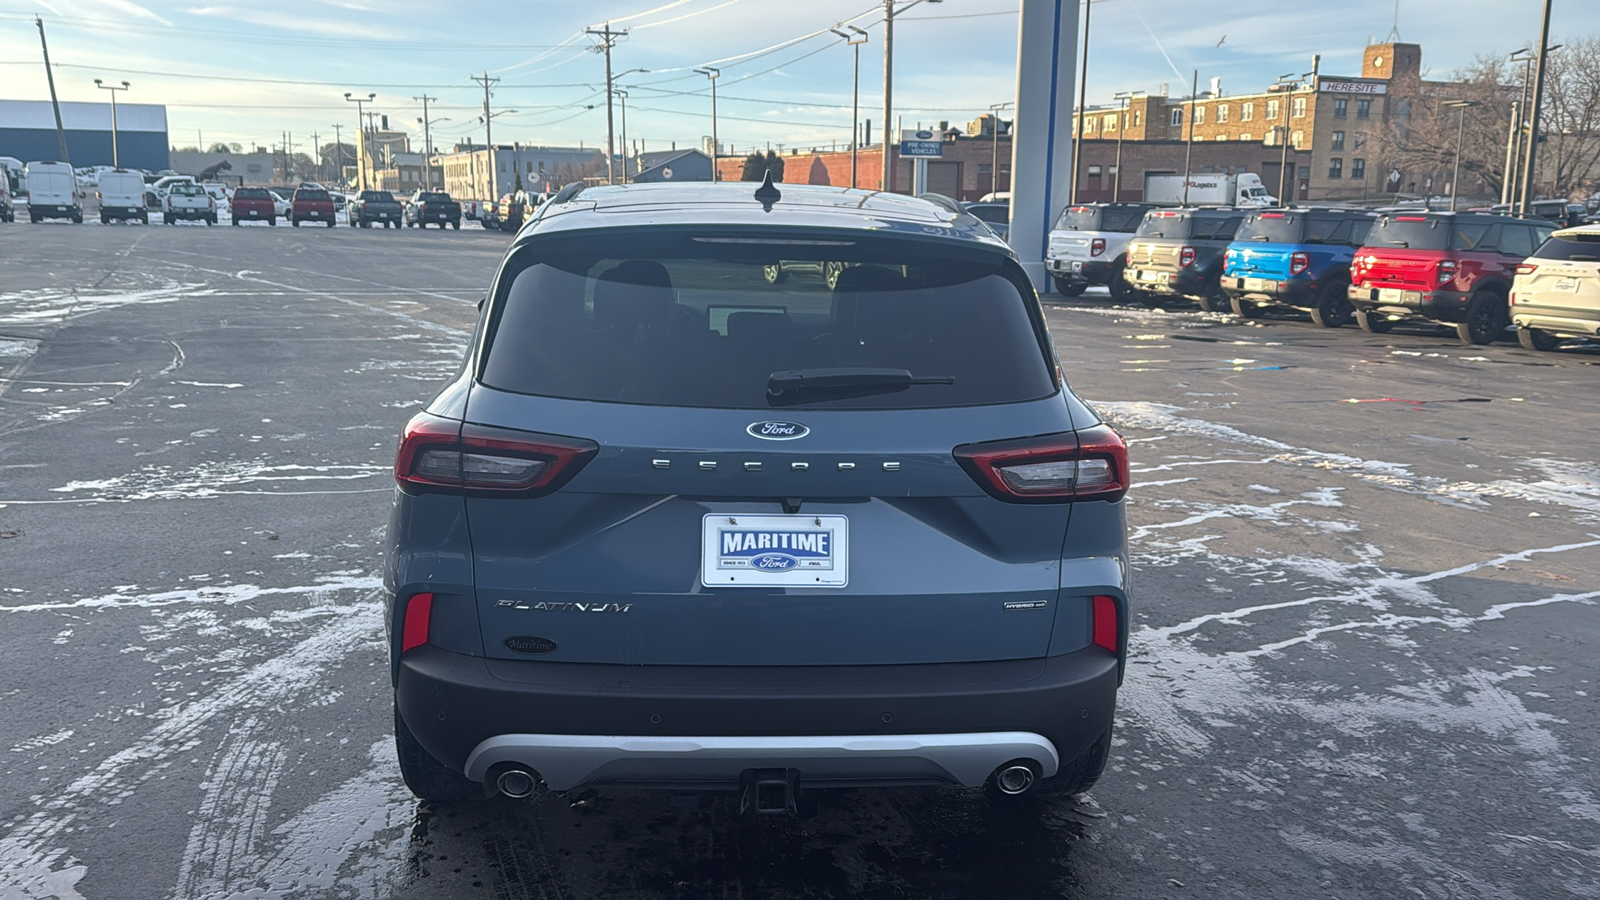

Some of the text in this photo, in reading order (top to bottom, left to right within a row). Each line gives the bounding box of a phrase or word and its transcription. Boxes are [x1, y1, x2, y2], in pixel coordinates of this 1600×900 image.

[1326, 82, 1377, 92] HERESITE
[761, 422, 795, 435] Ford
[652, 459, 900, 471] ESCAPE
[723, 532, 828, 555] MARITIME
[759, 556, 789, 568] Ford
[494, 599, 634, 613] PLATINUM
[508, 639, 553, 651] Maritime
